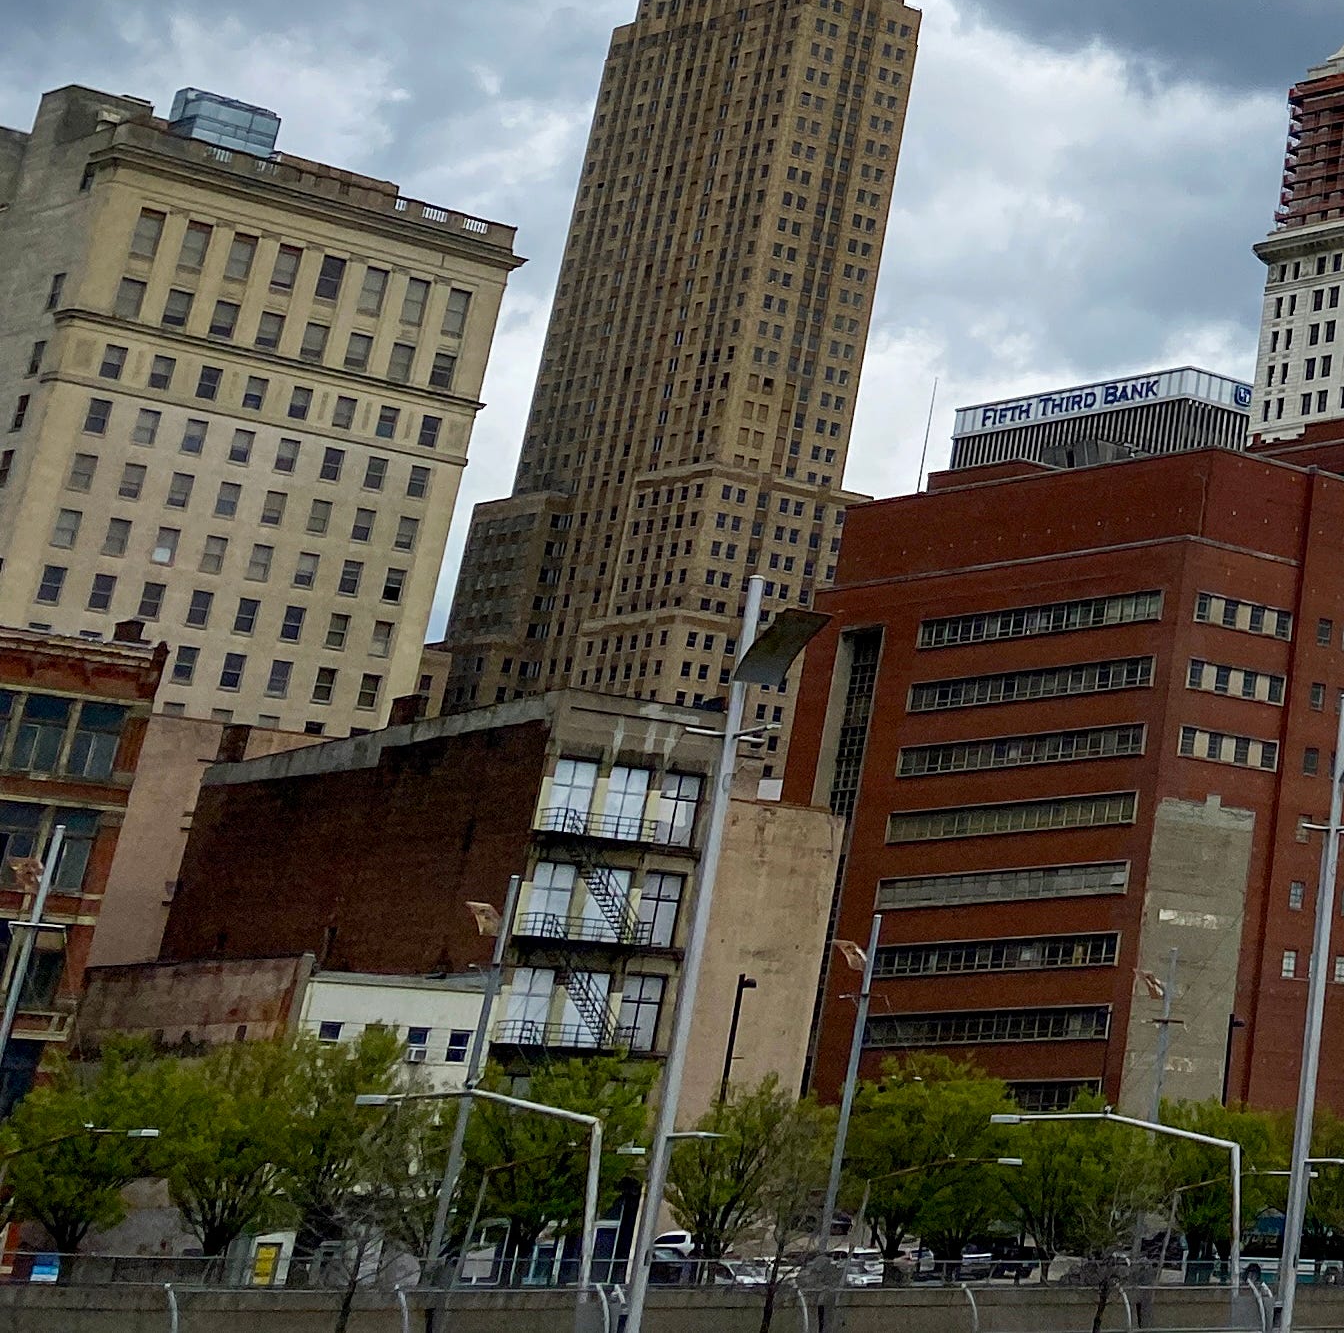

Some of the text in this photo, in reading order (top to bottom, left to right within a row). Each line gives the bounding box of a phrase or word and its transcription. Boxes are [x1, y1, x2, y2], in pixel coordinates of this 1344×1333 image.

[982, 380, 1159, 428] FIFTH THIRD BANK
